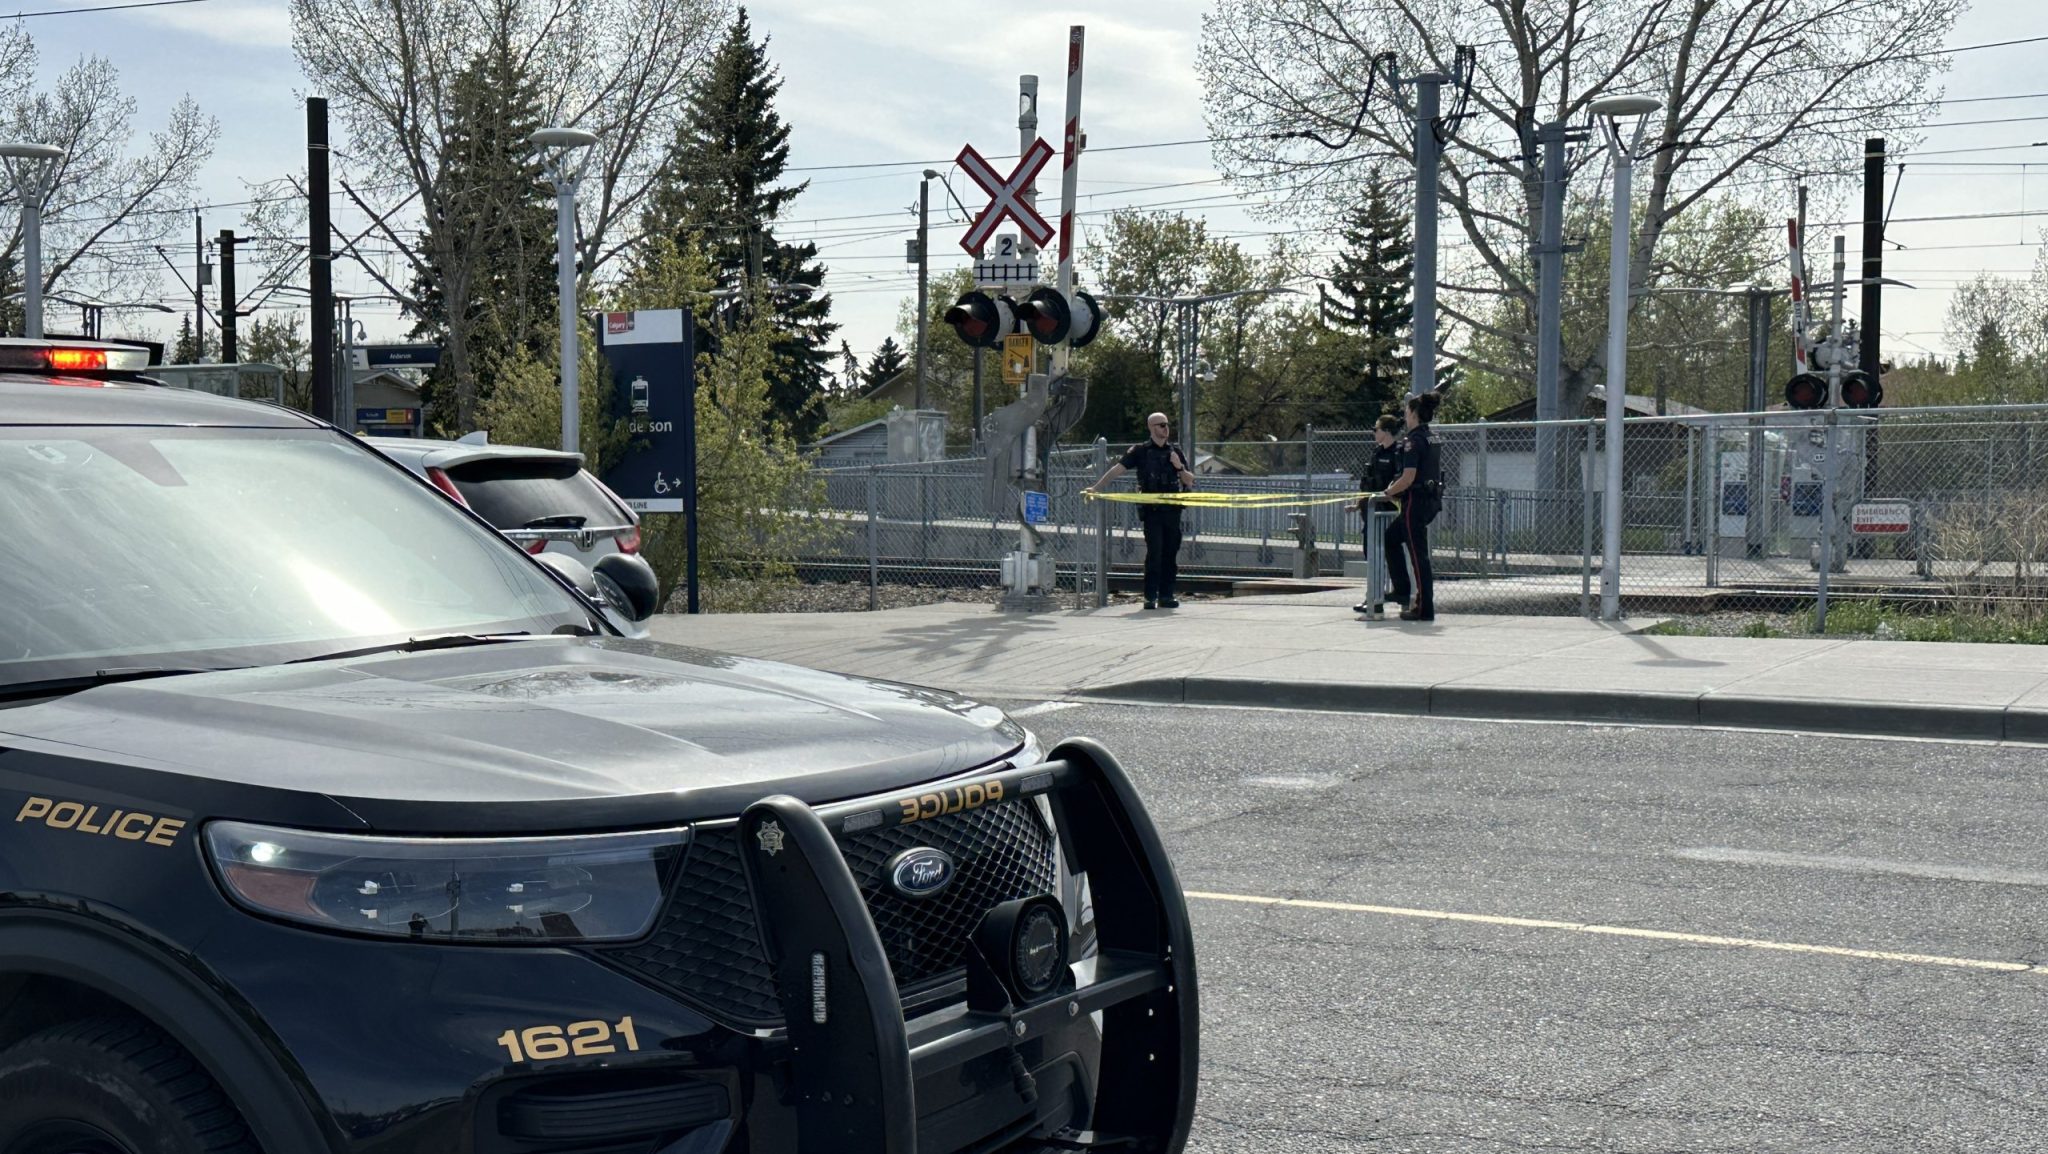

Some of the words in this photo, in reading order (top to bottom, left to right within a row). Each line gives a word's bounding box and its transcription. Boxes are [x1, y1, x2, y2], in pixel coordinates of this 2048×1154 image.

[1001, 238, 1012, 256] 2
[613, 418, 673, 433] Adeson
[633, 501, 648, 509] LINE
[15, 796, 187, 847] POLICE
[912, 860, 944, 886] Ford
[497, 1016, 640, 1063] 1621
